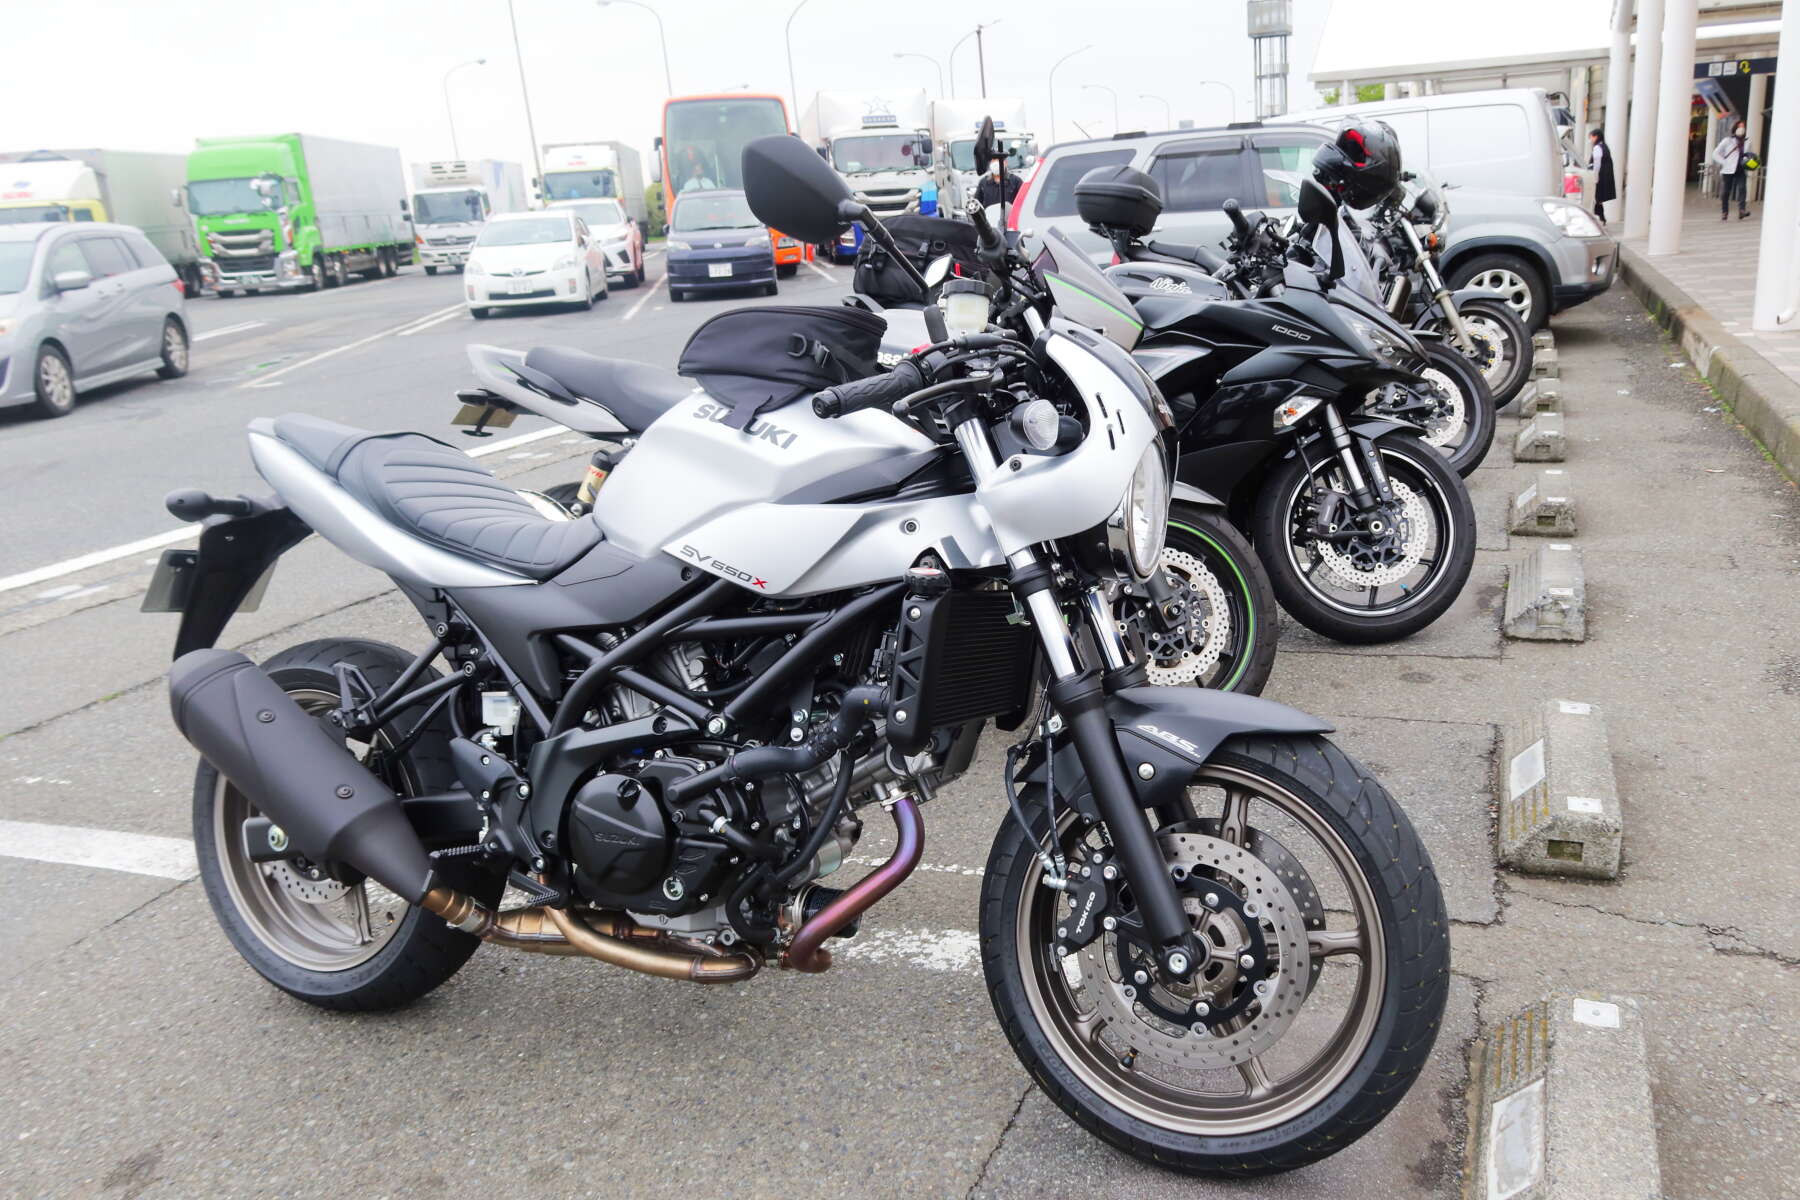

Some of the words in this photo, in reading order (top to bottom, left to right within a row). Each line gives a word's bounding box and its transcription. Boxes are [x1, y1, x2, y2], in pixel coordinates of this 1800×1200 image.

[1150, 277, 1193, 295] Ninja
[1271, 324, 1311, 341] 1000
[692, 404, 798, 449] SUUKI
[1137, 724, 1200, 756] ABS
[1076, 891, 1096, 934] TOKICO
